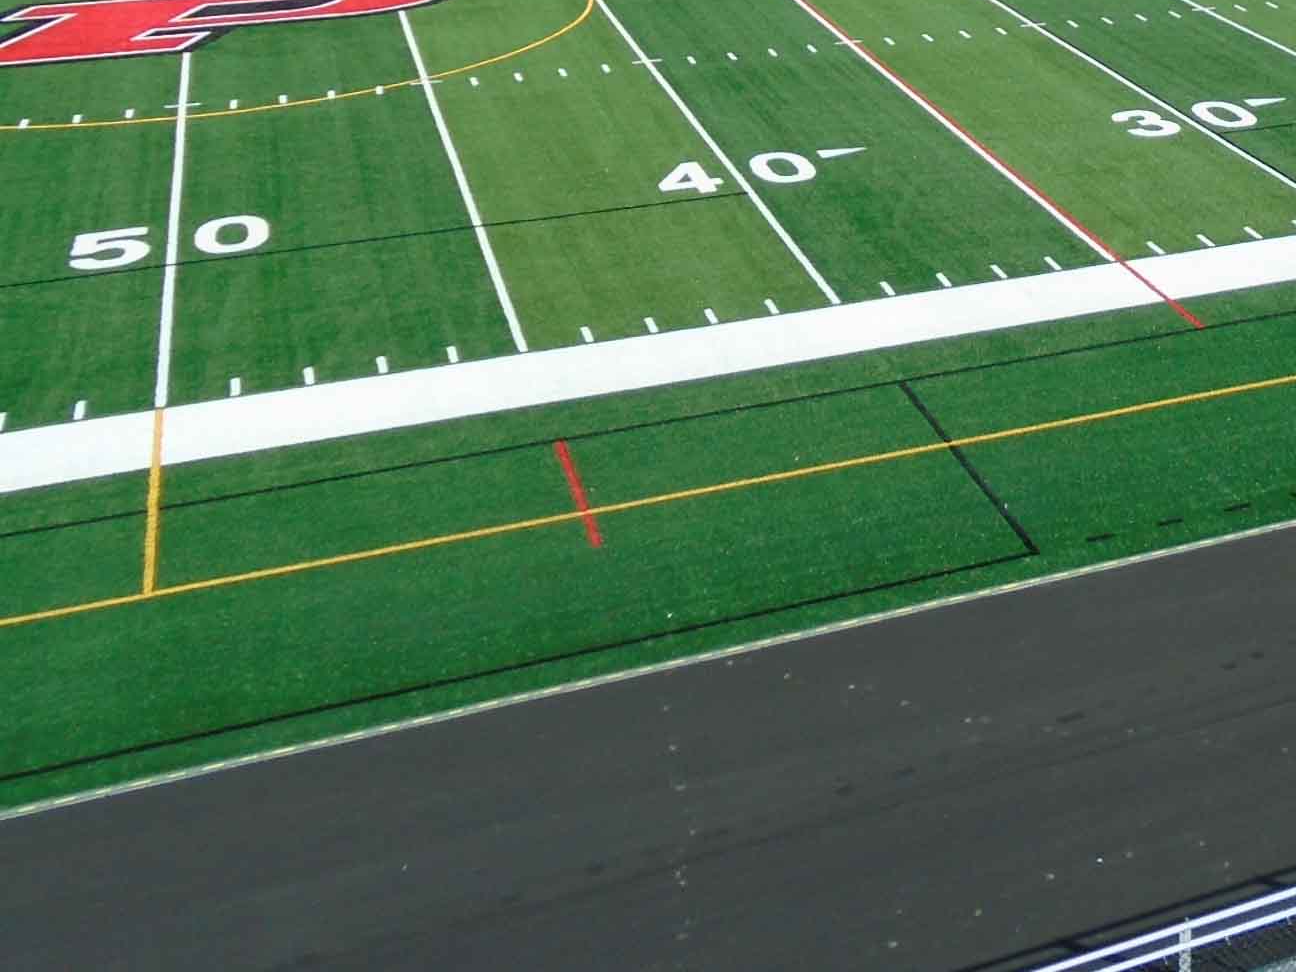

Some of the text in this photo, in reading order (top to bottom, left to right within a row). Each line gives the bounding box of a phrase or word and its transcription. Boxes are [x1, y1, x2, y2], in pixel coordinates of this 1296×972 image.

[1111, 100, 1258, 138] 30
[657, 150, 818, 194] 40
[68, 214, 271, 270] 50
